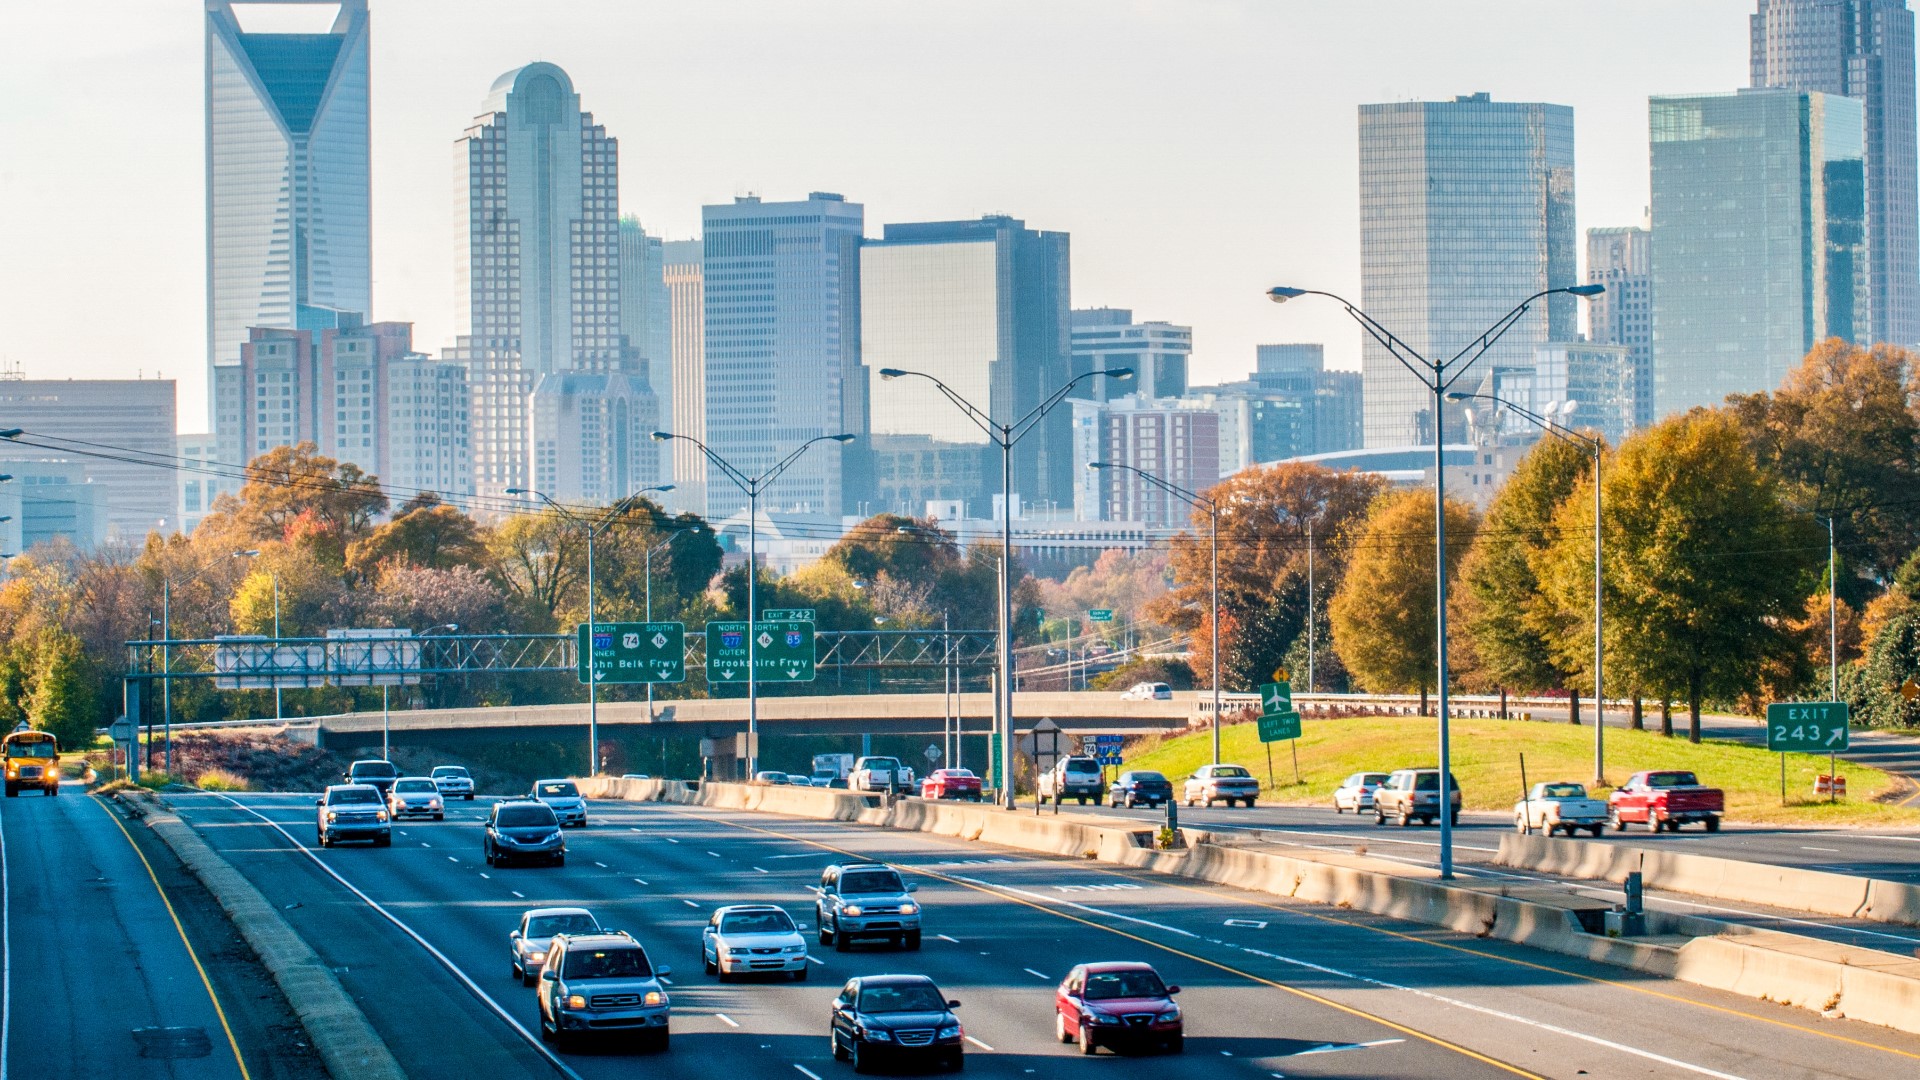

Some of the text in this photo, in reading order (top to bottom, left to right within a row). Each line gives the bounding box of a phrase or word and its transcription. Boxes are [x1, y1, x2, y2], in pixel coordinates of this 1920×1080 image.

[789, 611, 810, 619] 242
[595, 636, 664, 646] 277 74 16
[724, 635, 800, 646] 277 16 85
[619, 660, 643, 668] Belk
[650, 659, 677, 669] Frwy
[779, 659, 807, 668] Frwy
[1789, 709, 1828, 719] EXIT
[1263, 720, 1278, 728] LEFT
[1270, 727, 1290, 736] LANES
[1774, 725, 1820, 741] 243
[1085, 745, 1095, 753] 74
[1100, 745, 1109, 754] 77
